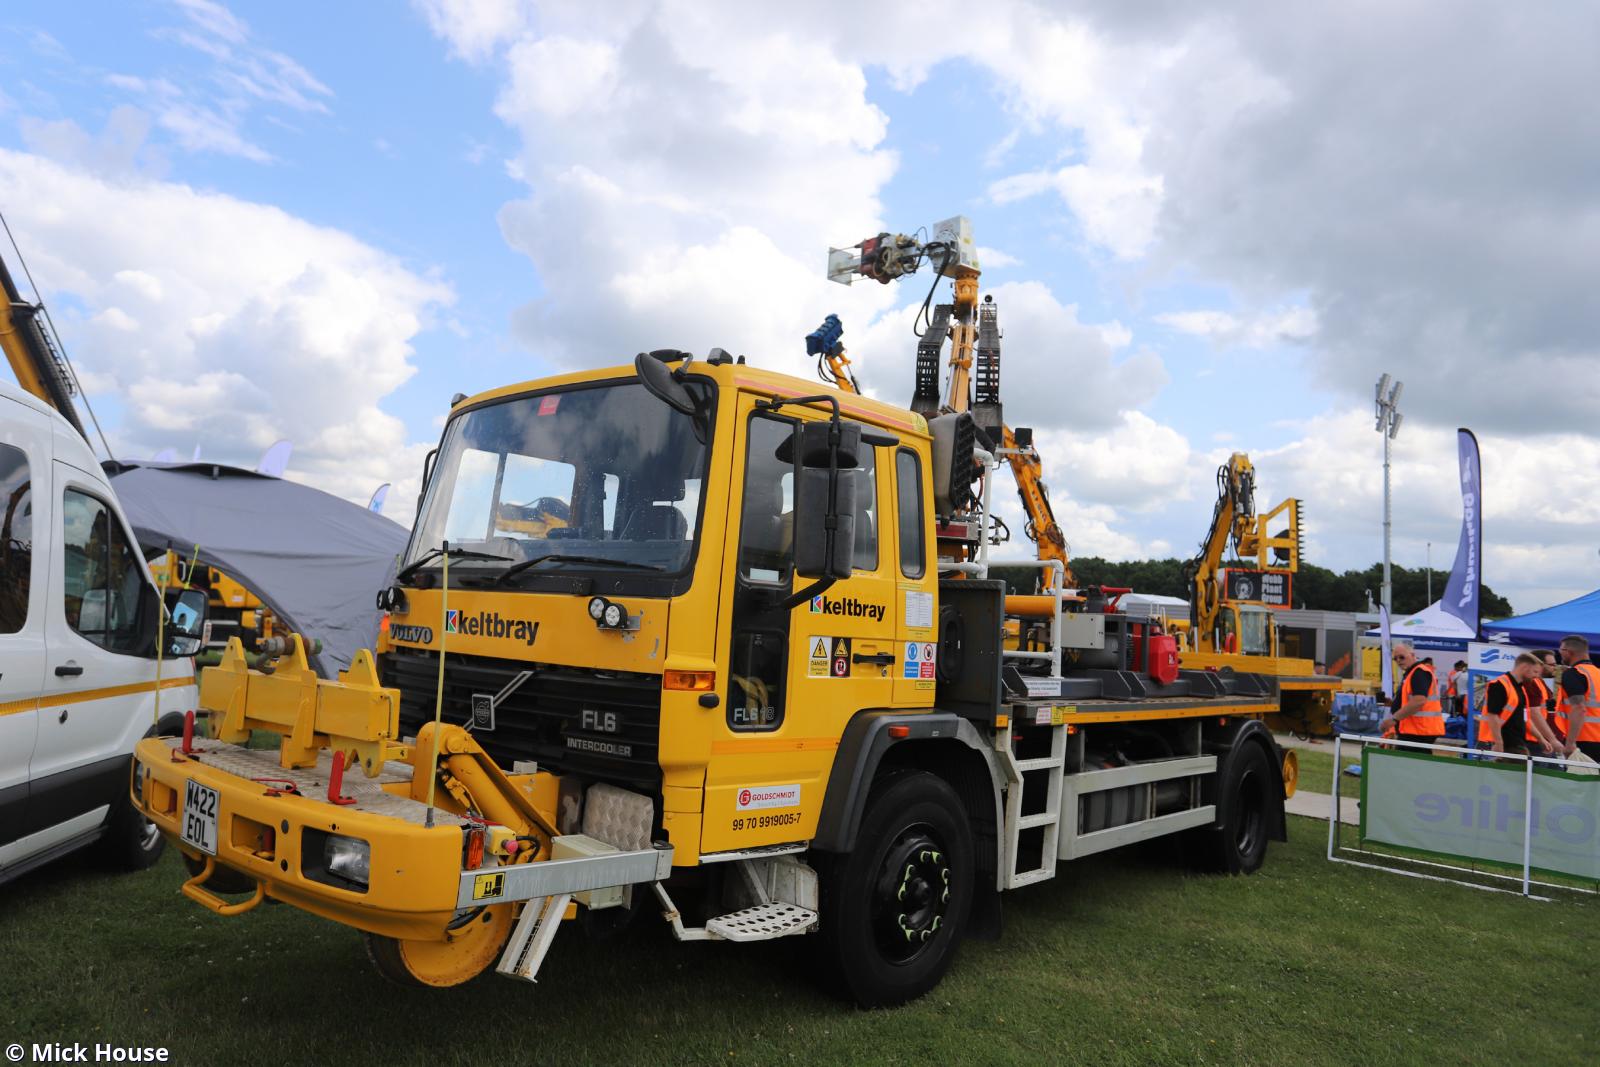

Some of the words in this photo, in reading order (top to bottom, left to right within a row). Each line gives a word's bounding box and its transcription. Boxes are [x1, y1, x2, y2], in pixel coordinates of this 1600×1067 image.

[822, 595, 886, 622] keltbray
[389, 623, 433, 644] VOLVO
[458, 610, 540, 646] keltbray
[581, 709, 617, 733] FL6
[566, 737, 633, 757] INTERCOOLER
[752, 791, 796, 801] GOLDSCHMIDT
[187, 813, 209, 848] EOL
[732, 819, 744, 831] 99
[746, 817, 757, 829] 70
[759, 812, 802, 828] 9919005-7
